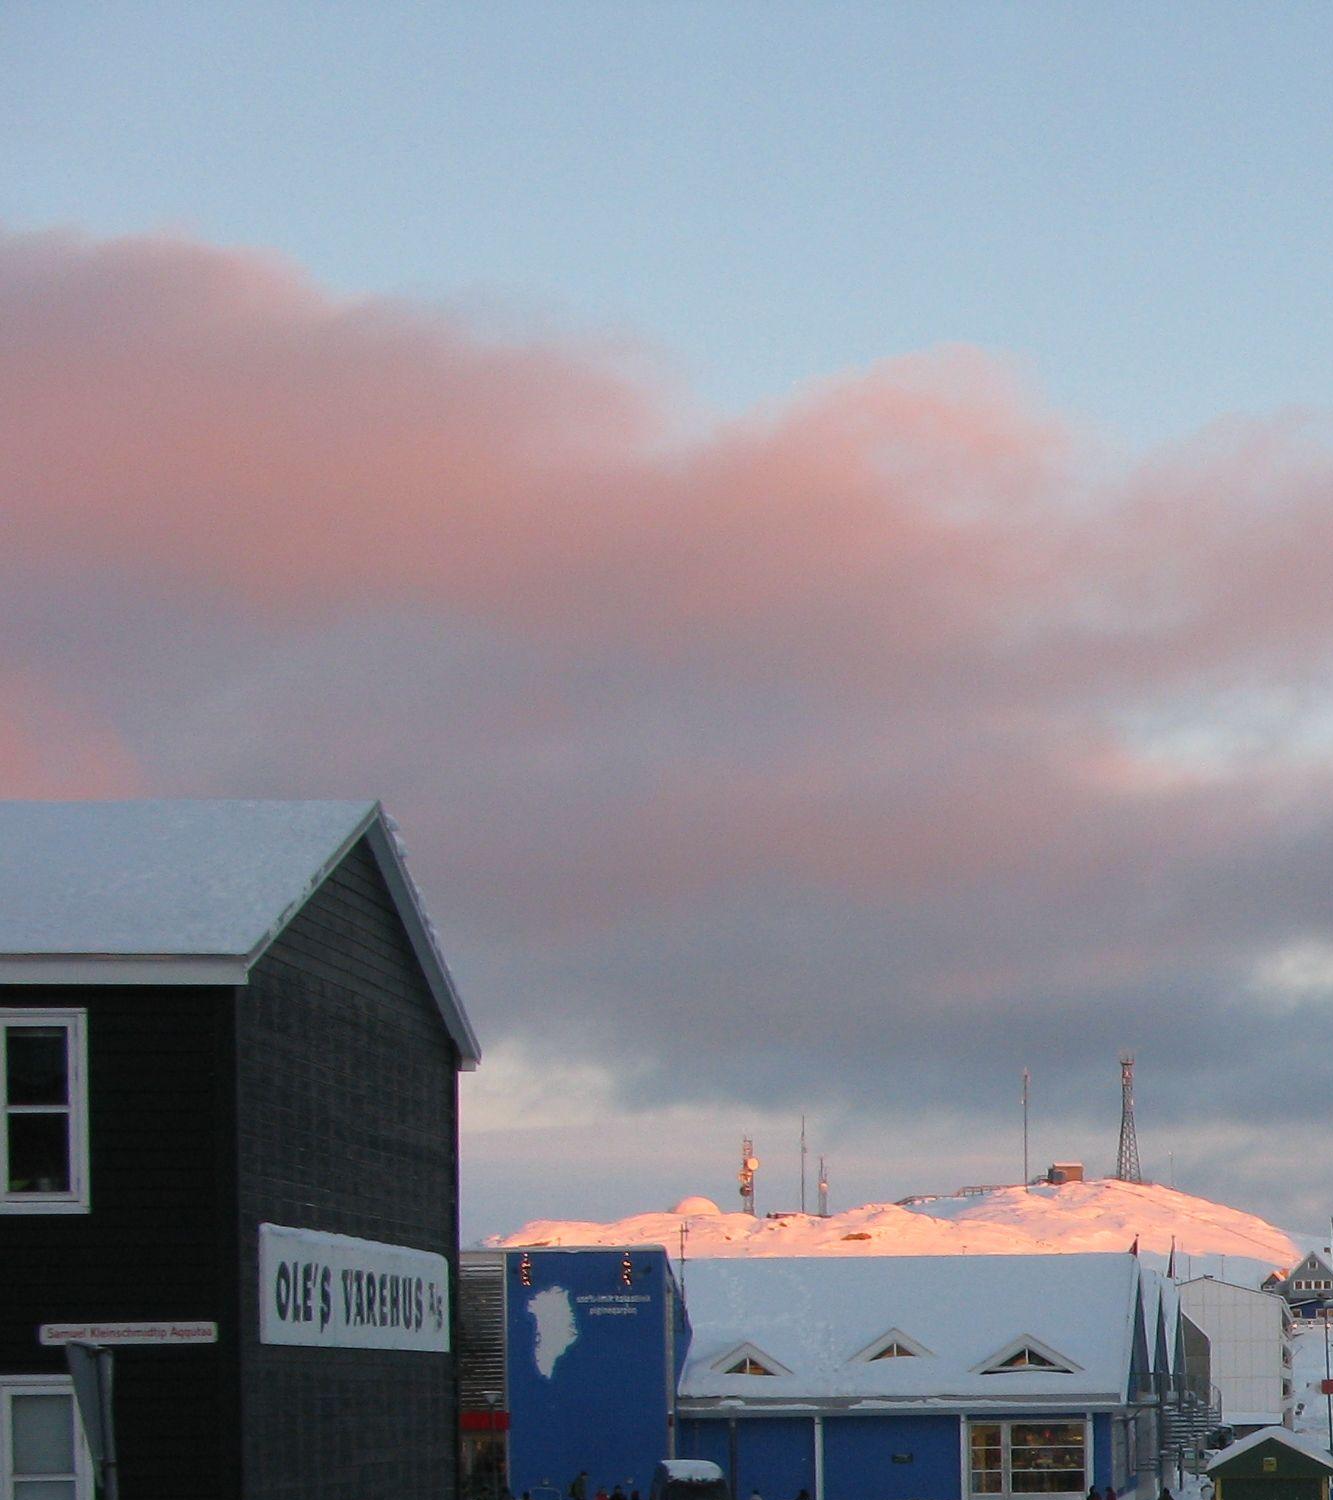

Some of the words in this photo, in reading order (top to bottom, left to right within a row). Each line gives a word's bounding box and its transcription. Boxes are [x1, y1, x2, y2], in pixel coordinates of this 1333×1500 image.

[276, 1261, 332, 1333] OLE'S
[341, 1269, 423, 1332] VAREHUS
[47, 1329, 85, 1339] Samuel
